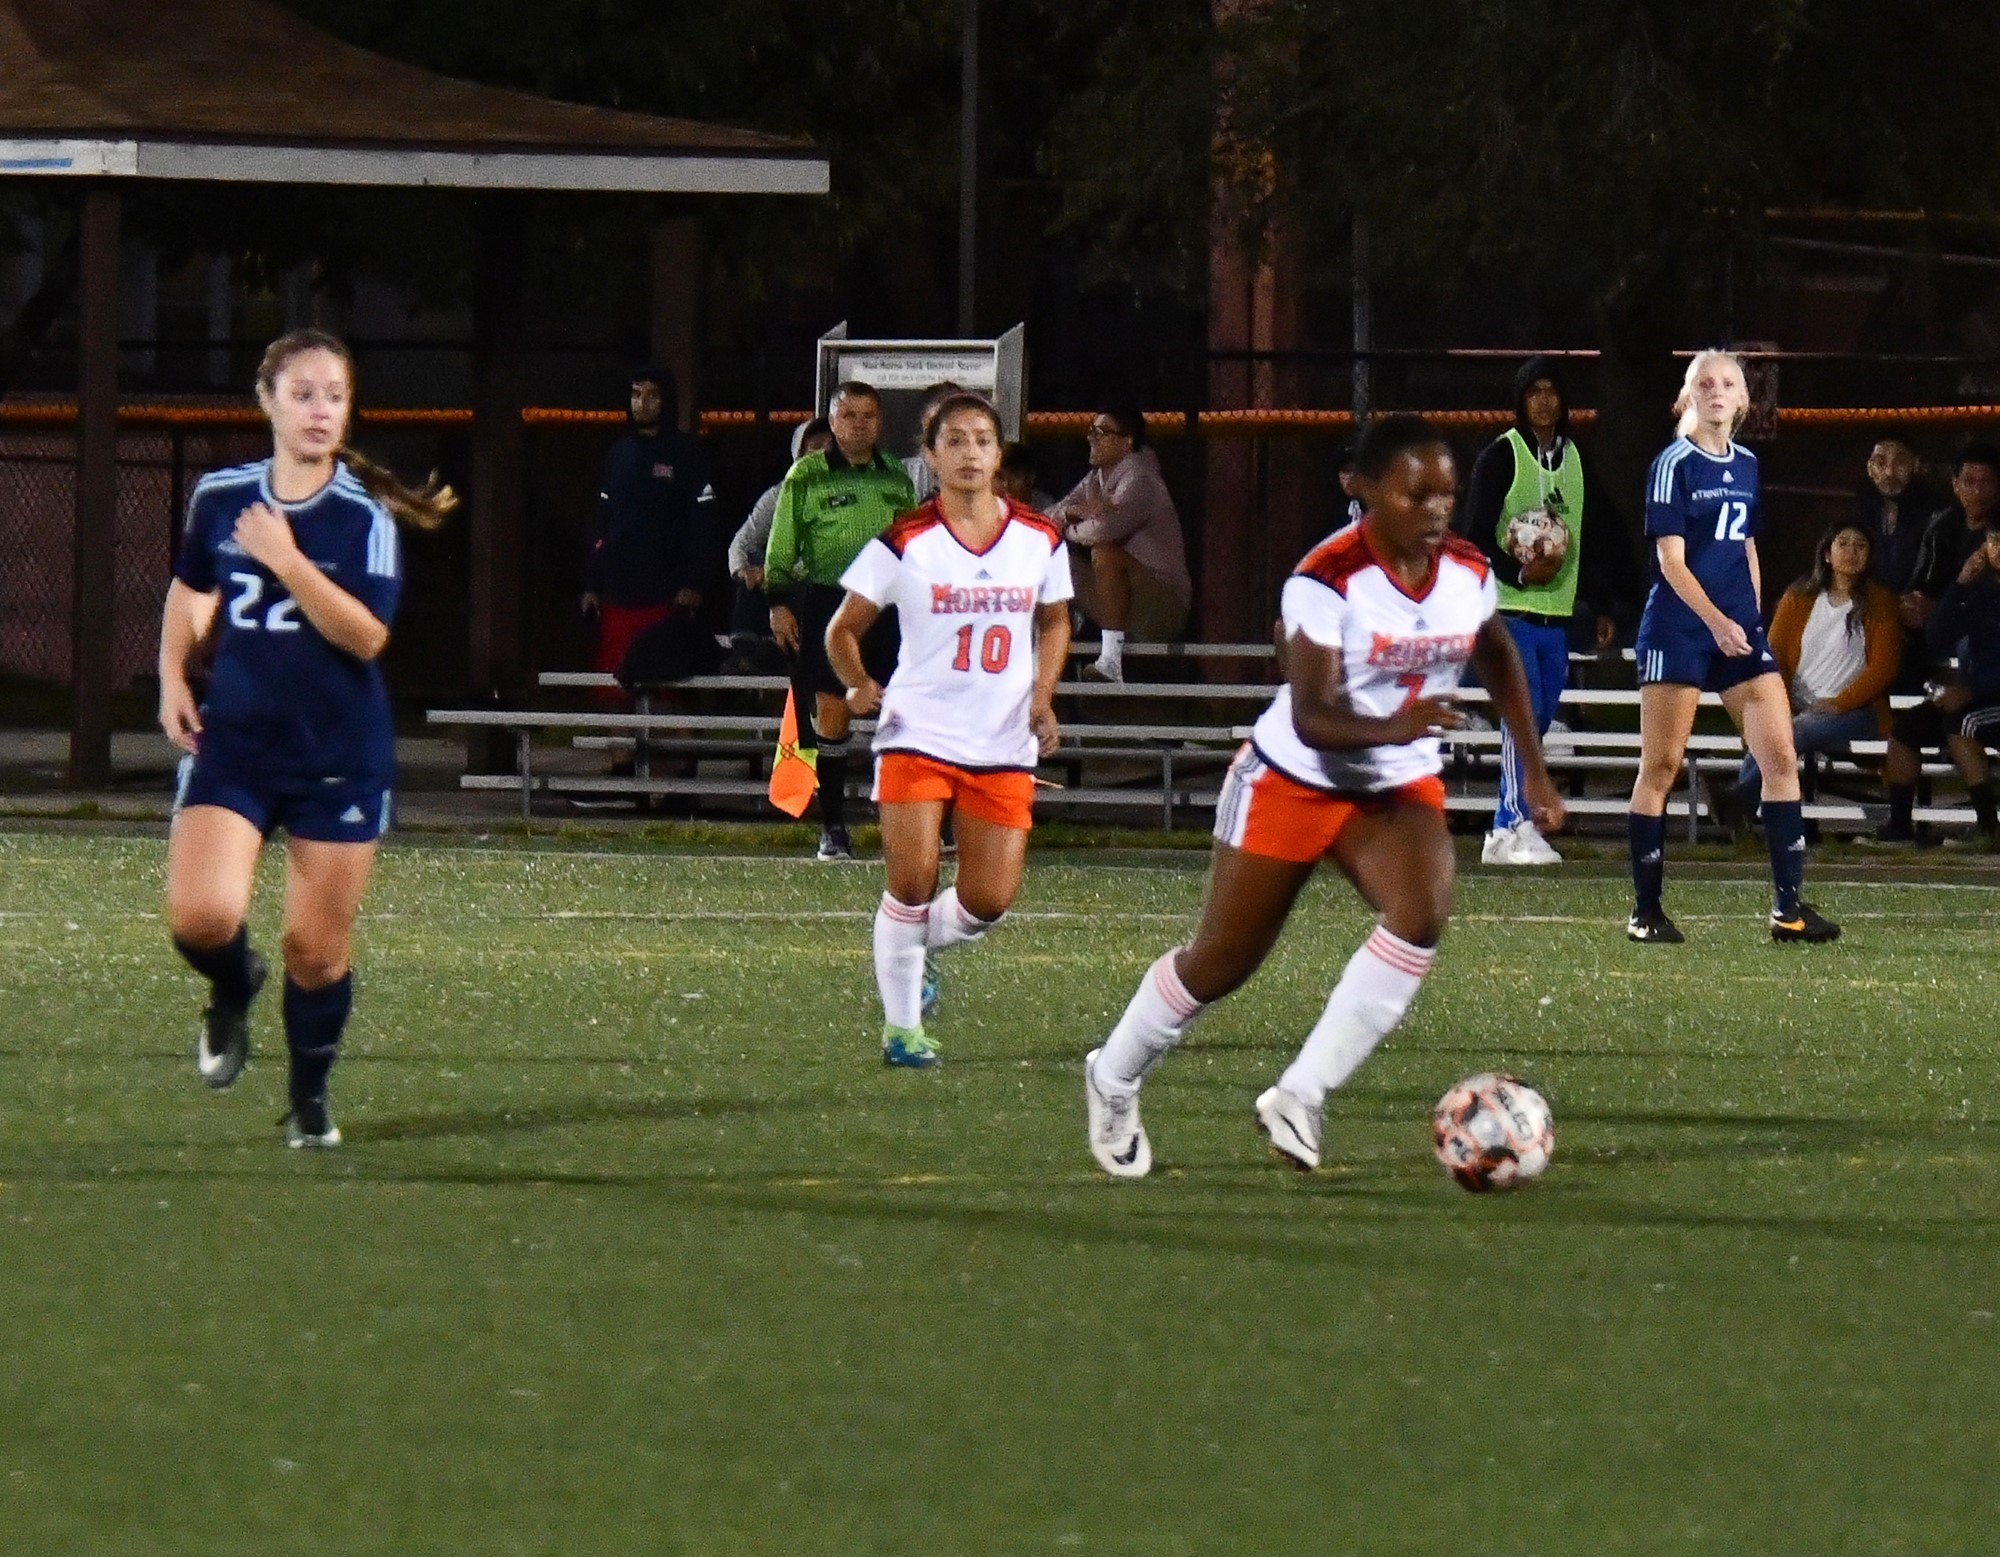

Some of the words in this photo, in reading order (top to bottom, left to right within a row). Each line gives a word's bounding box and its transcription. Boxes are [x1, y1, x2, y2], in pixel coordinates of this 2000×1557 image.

[1715, 501, 1747, 541] 12
[229, 571, 300, 631] 22
[952, 623, 1012, 674] 10
[1395, 673, 1427, 714] 7
